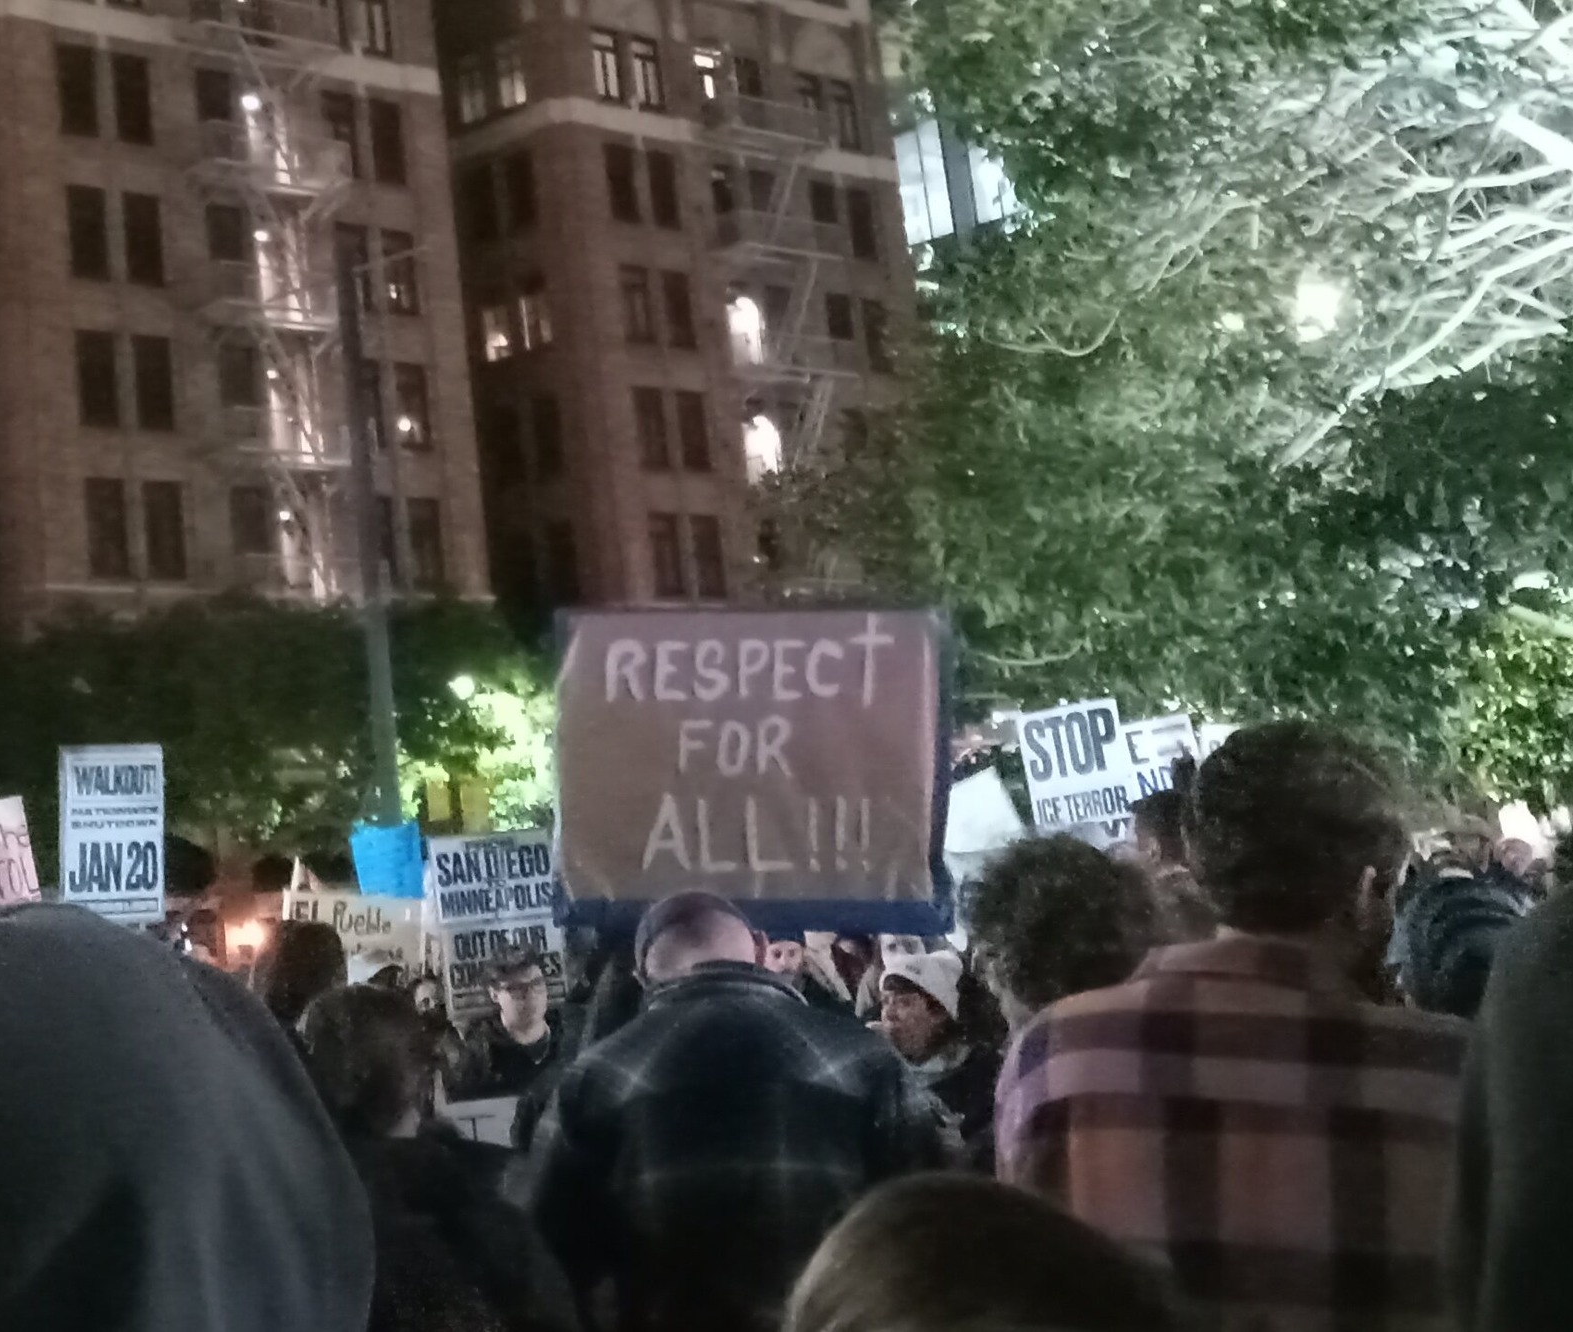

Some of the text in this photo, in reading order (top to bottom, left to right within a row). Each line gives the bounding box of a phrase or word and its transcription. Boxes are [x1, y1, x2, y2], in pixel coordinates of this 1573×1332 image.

[678, 714, 794, 778] FOR
[1023, 707, 1117, 783] STOP
[1036, 784, 1130, 825] ICE TERROR
[641, 791, 873, 873] ALL!!!
[69, 840, 159, 893] JAN 20
[435, 849, 483, 888] SAN
[483, 842, 551, 880] DIEGO
[439, 880, 554, 919] MINNEAPOLIS
[454, 930, 486, 961] OUT
